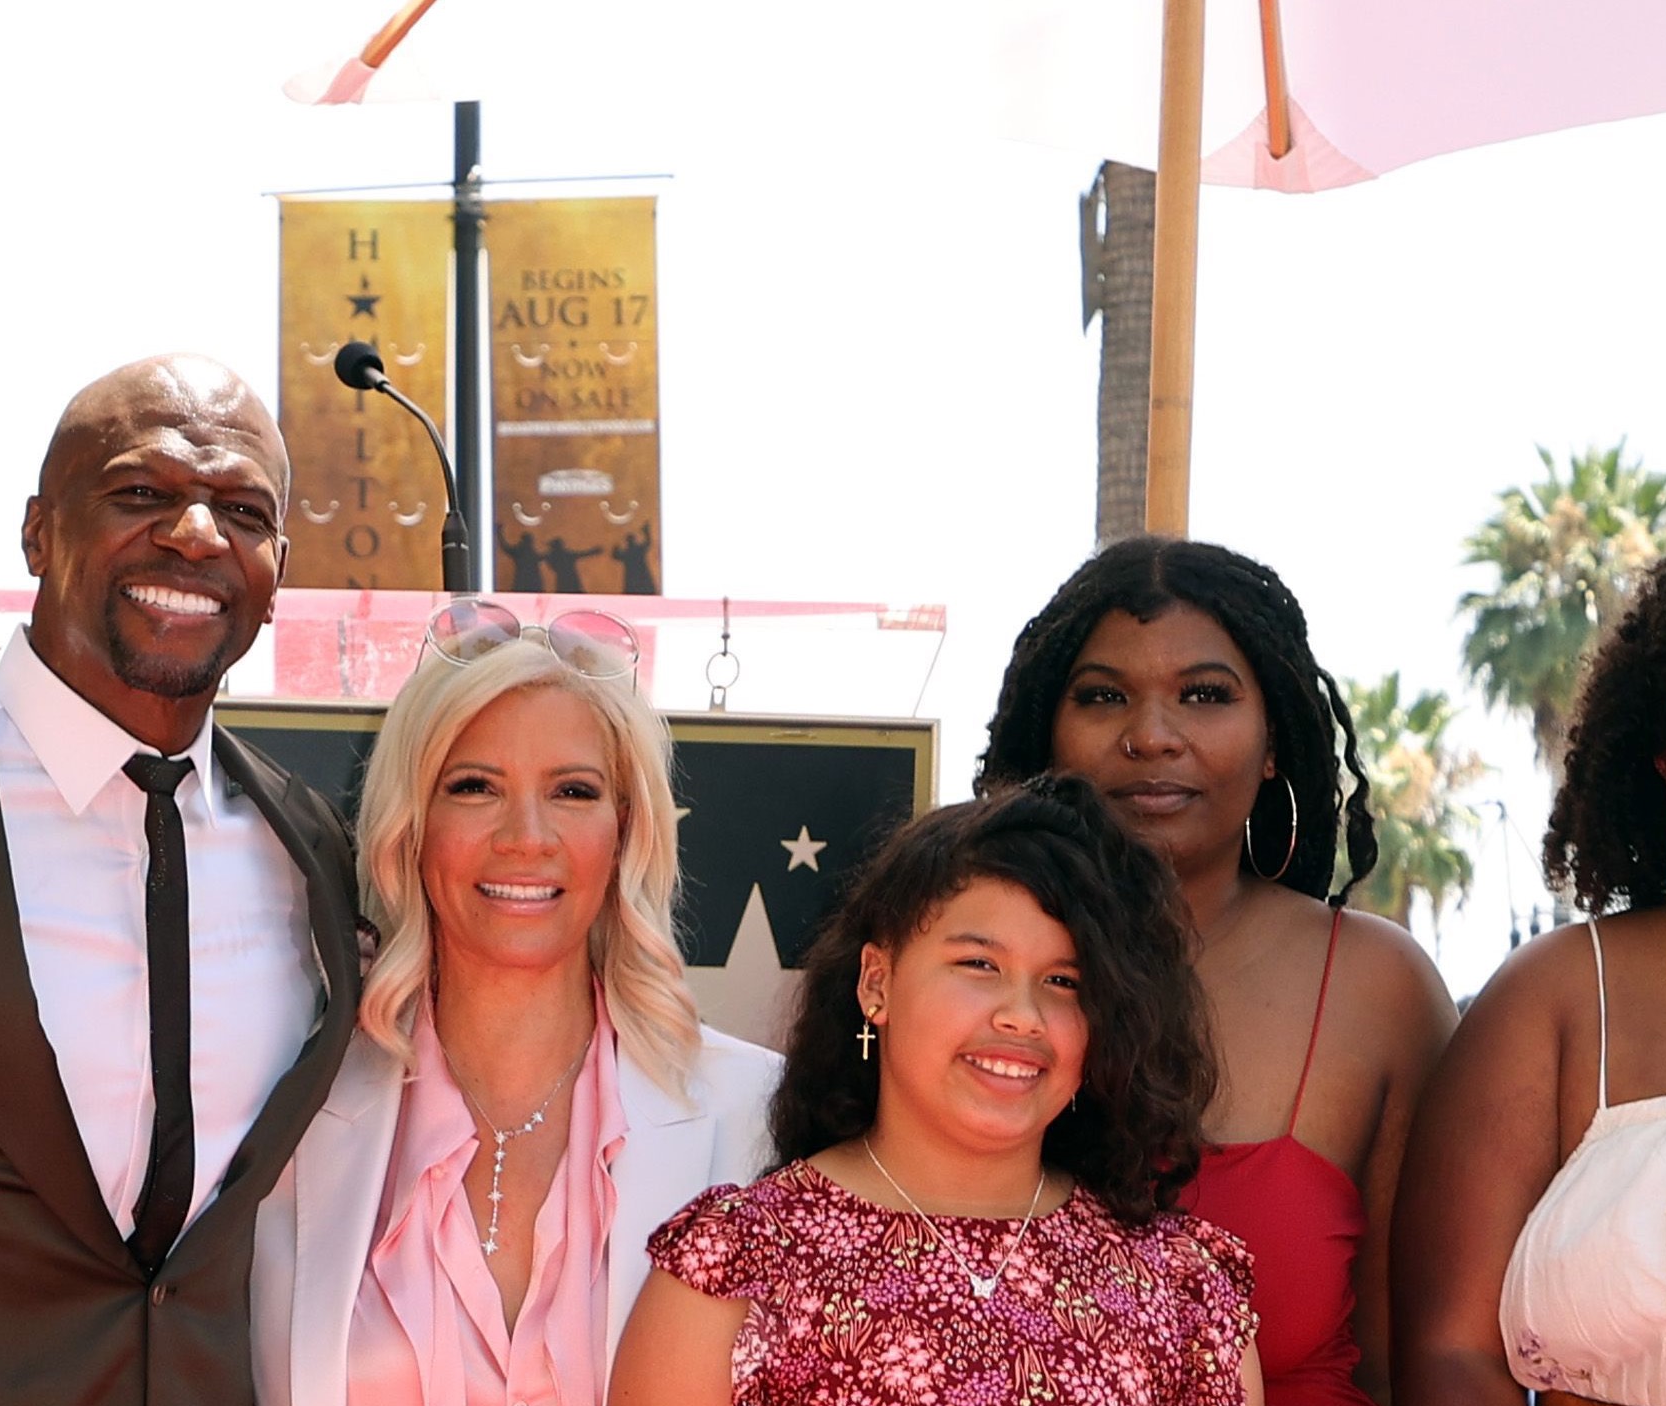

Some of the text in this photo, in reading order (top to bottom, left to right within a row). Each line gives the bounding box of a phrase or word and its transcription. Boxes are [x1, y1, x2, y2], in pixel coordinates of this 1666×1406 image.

[521, 268, 626, 291] BEGINS
[498, 294, 649, 329] AUG 17
[539, 358, 609, 380] NOW
[516, 386, 632, 410] ON SALE
